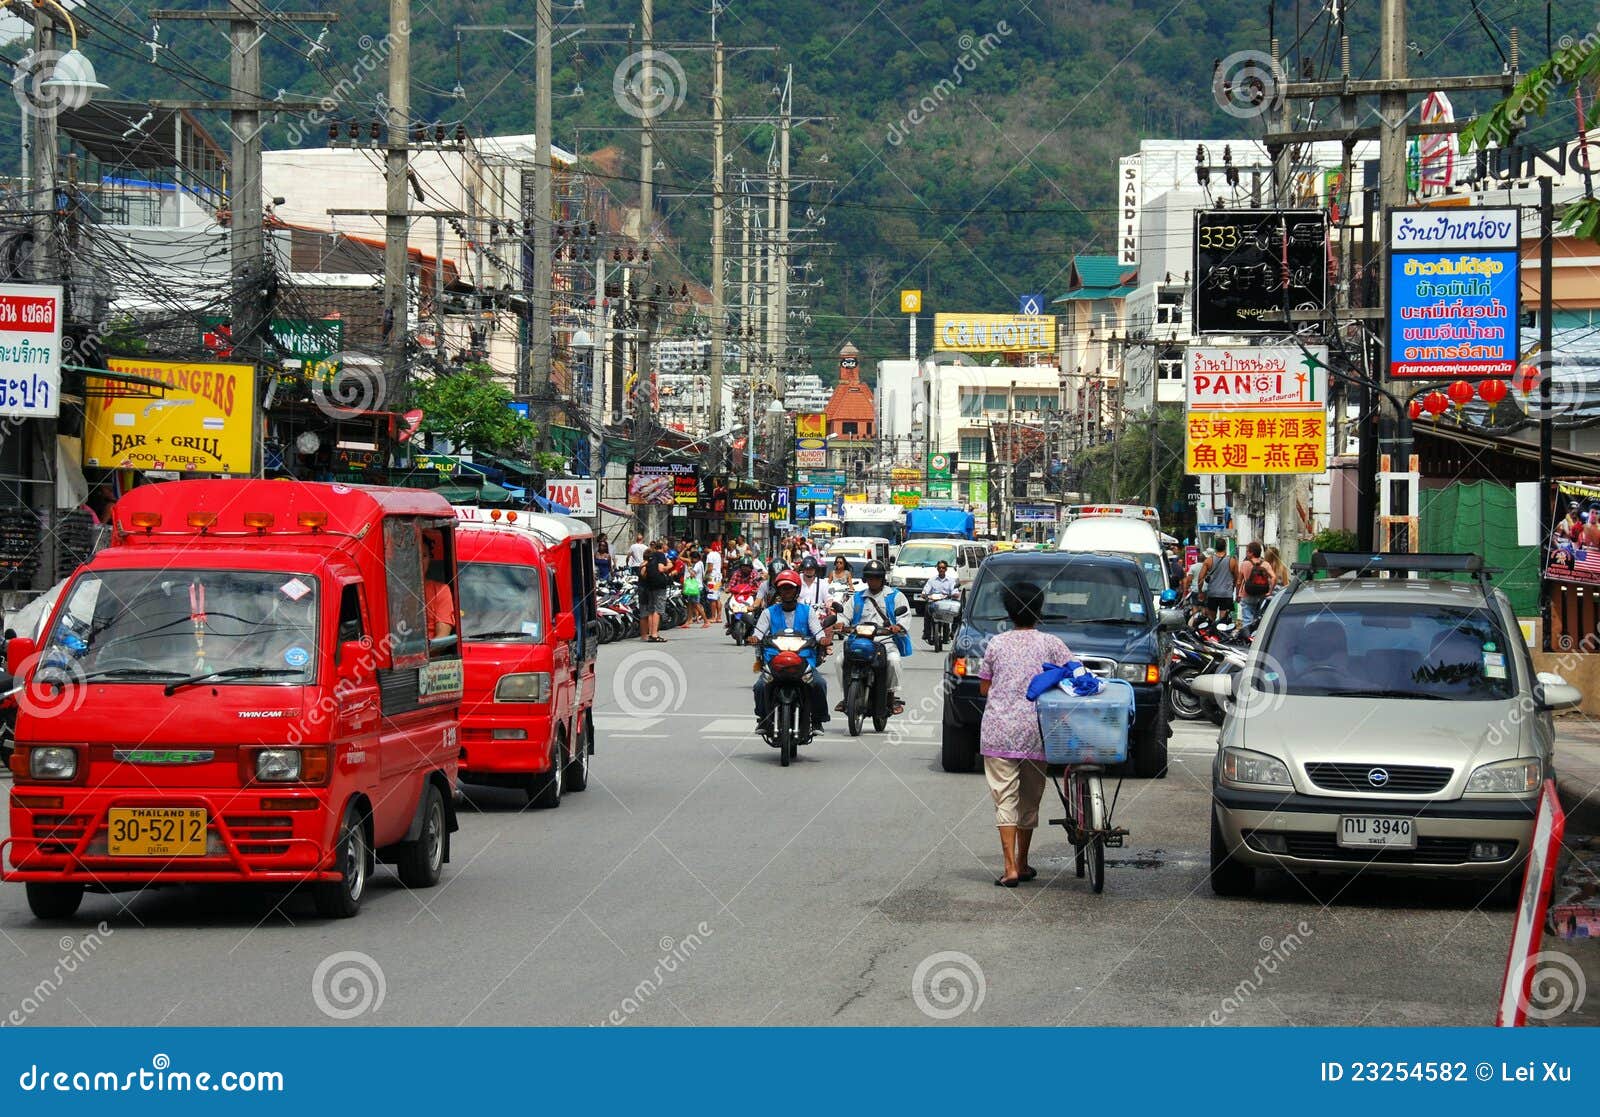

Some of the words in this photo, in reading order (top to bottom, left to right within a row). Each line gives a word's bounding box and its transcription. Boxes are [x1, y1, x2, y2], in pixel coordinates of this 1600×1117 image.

[991, 323, 1049, 348] HOTEL
[112, 433, 147, 457] BAR
[171, 436, 222, 462] GRILL
[128, 453, 159, 462] POOL
[164, 454, 207, 464] TABLES
[733, 500, 766, 510] TATTOO
[132, 809, 184, 817] THAILAND
[113, 819, 202, 841] 30-5212
[1345, 818, 1366, 833] กบ
[1373, 820, 1410, 834] 3940
